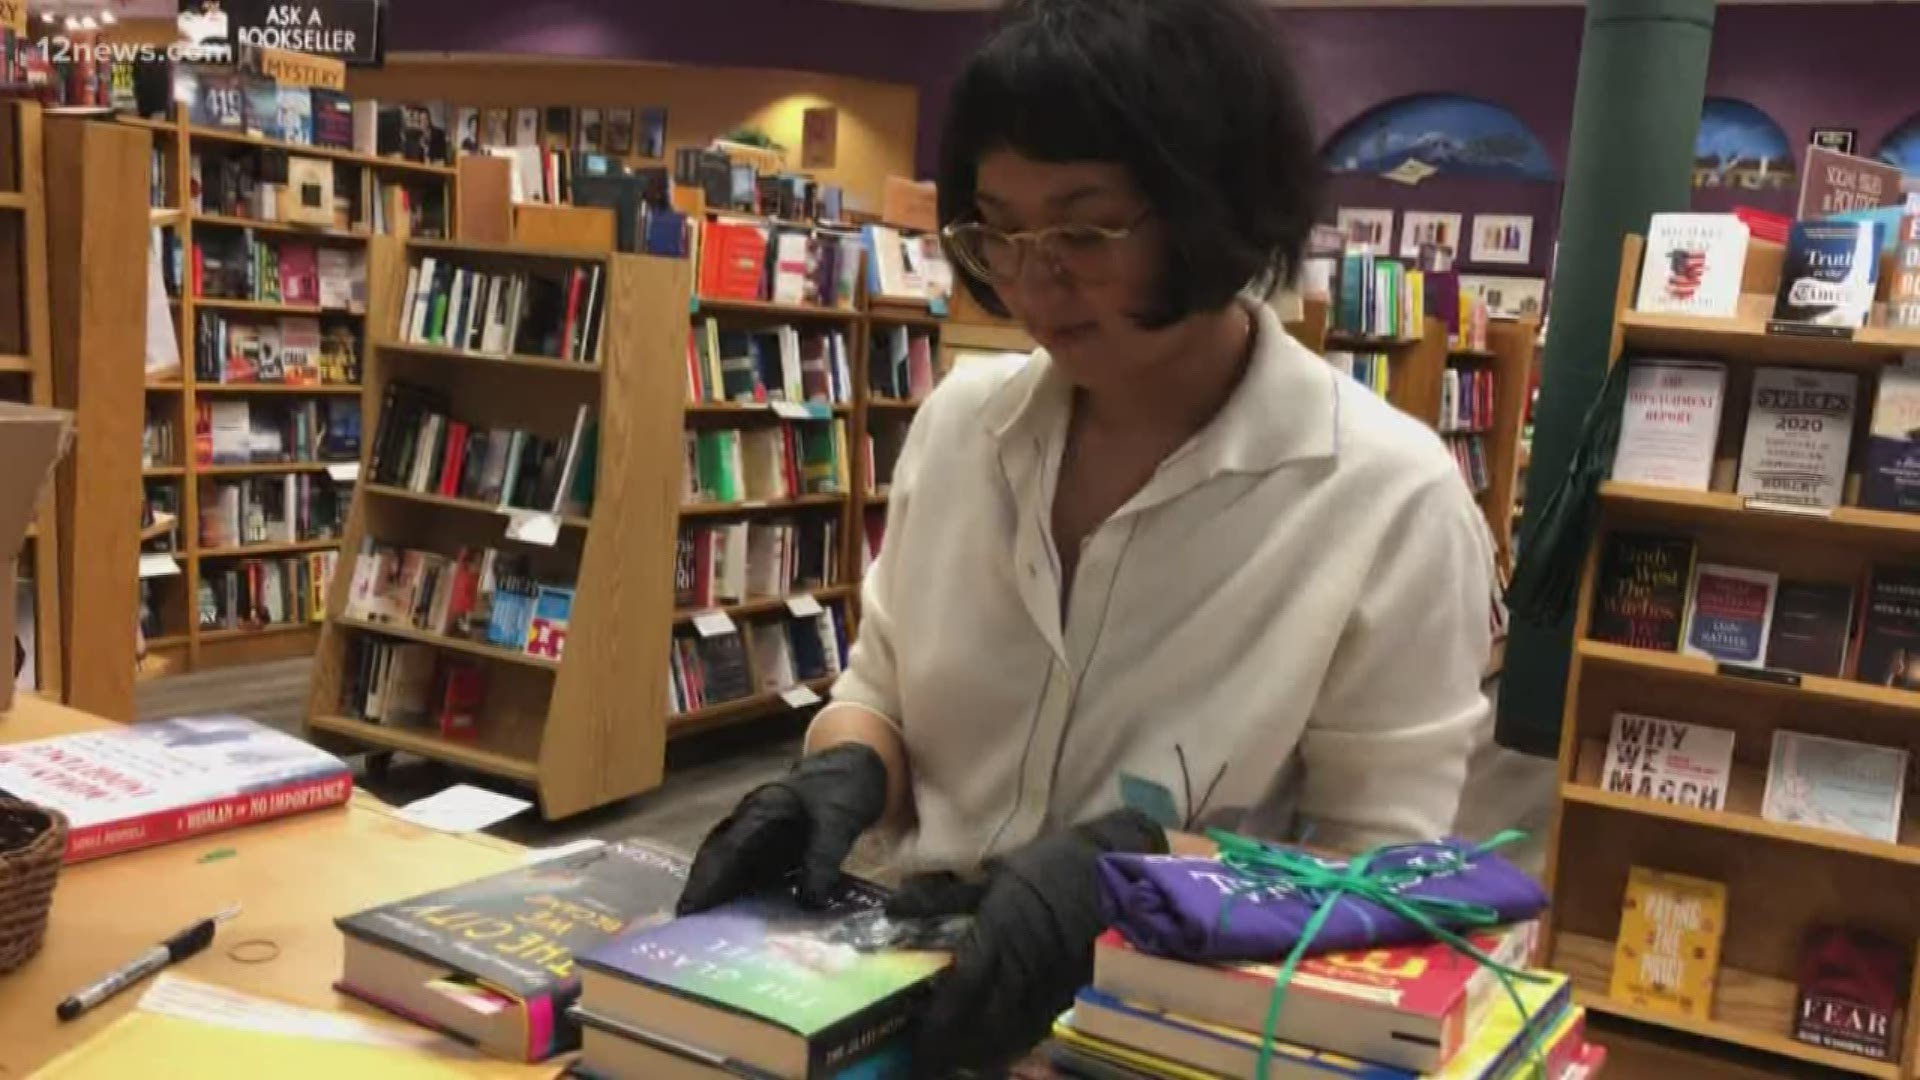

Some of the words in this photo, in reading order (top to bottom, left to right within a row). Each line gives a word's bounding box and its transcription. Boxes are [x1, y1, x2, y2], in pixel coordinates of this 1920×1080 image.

[265, 4, 301, 26] ASK
[307, 5, 322, 27] A
[237, 25, 357, 54] BOOKSELLER
[264, 56, 341, 85] MYSTERY
[1757, 387, 1851, 411] STAKES
[1775, 416, 1824, 434] 2020
[1621, 718, 1690, 750] WHY
[1616, 742, 1661, 774] WE
[250, 796, 268, 817] NO
[269, 779, 347, 812] IMPORTANCE
[494, 930, 574, 979] THE
[1803, 998, 1887, 1037] FEAR
